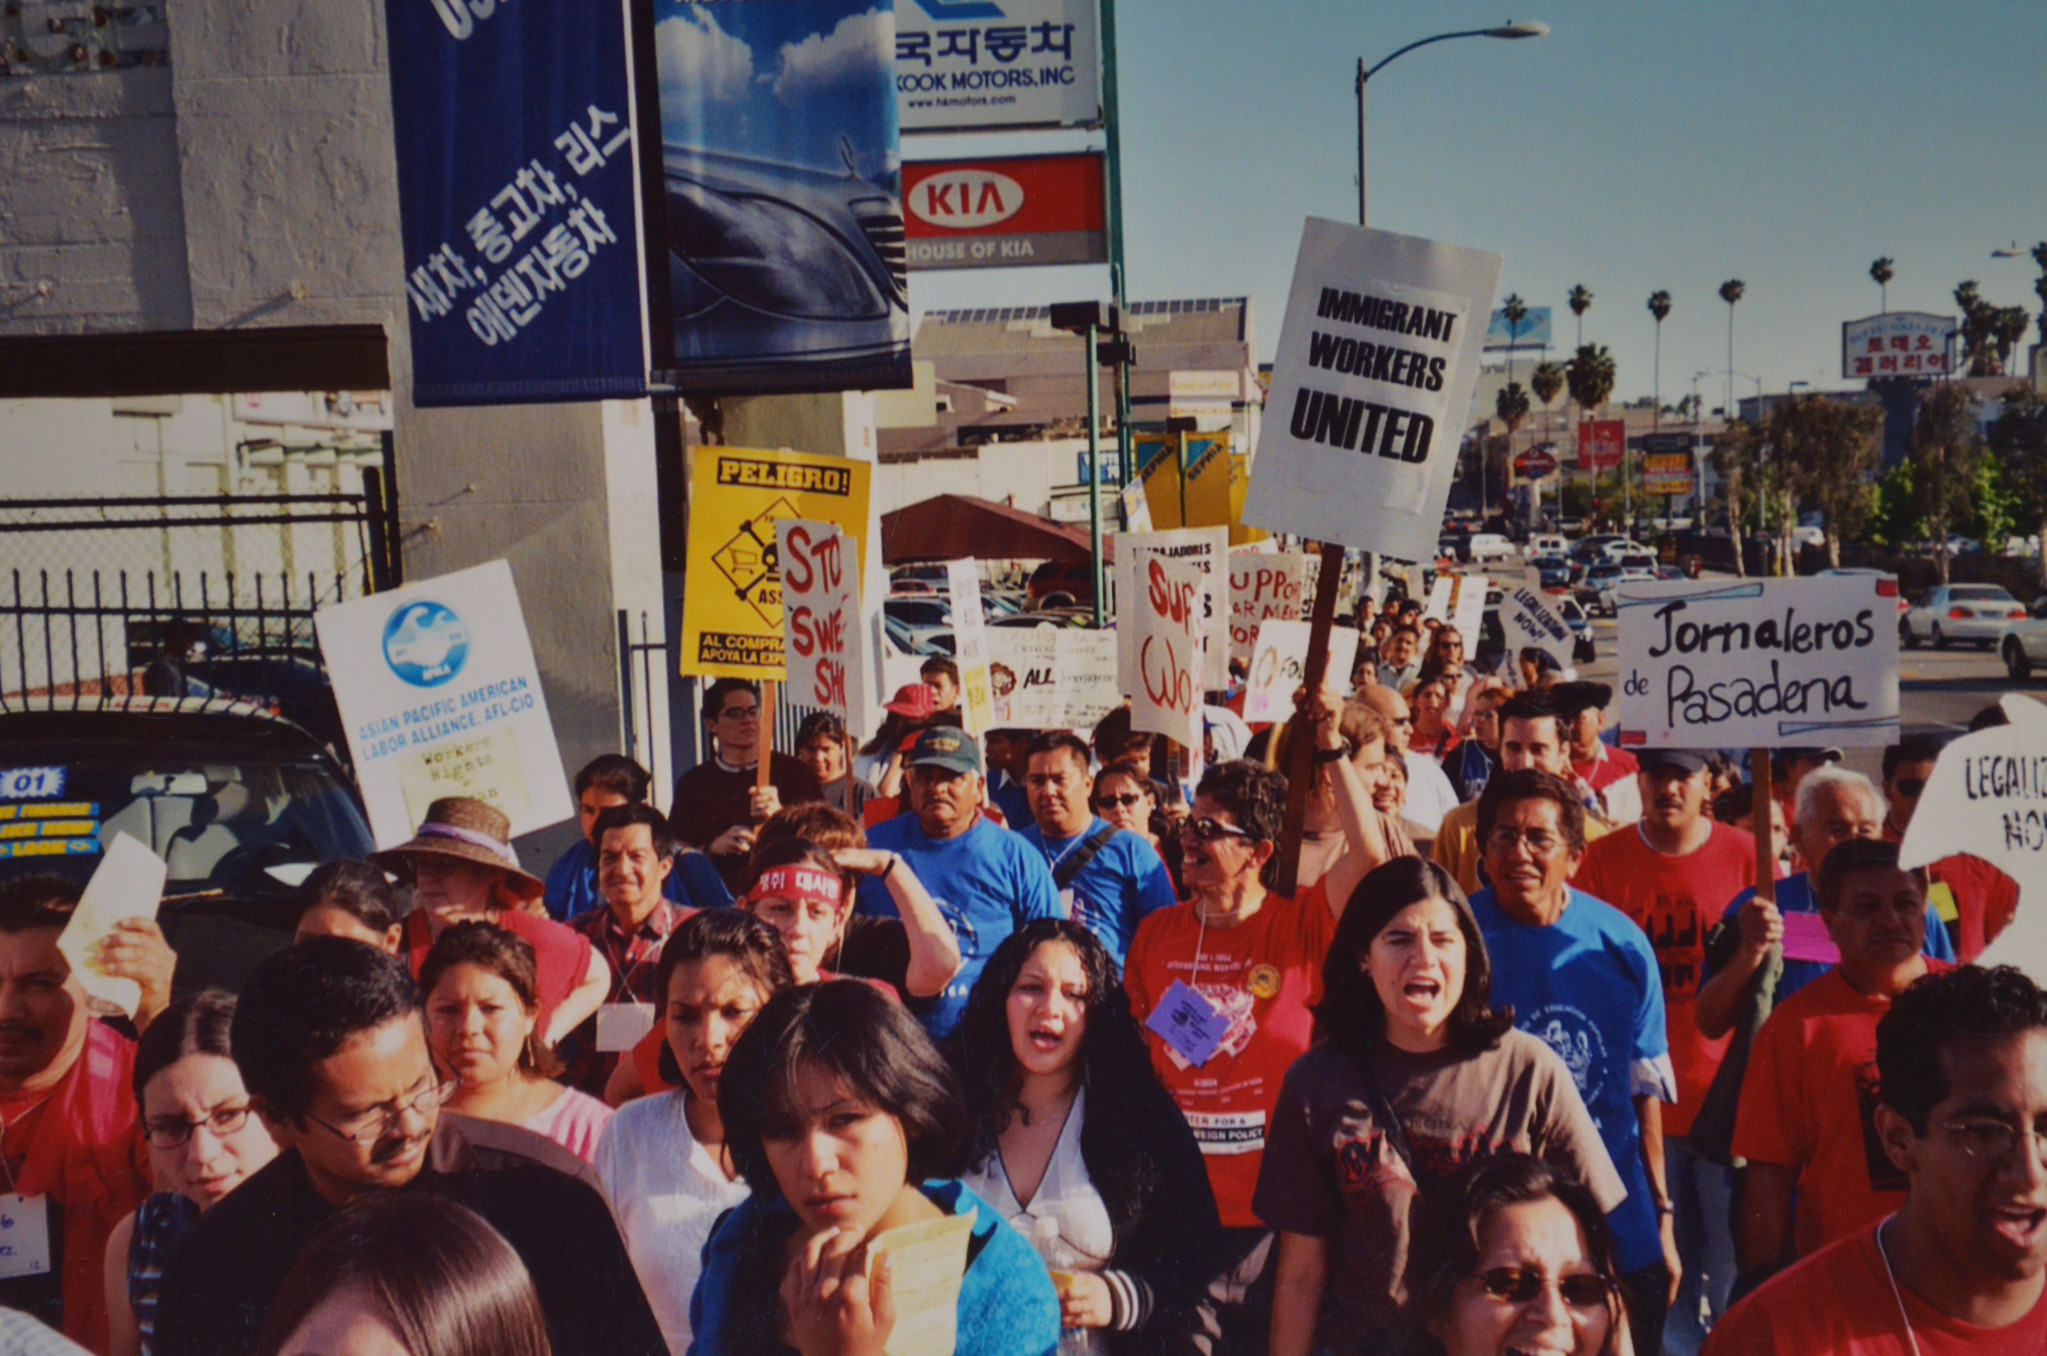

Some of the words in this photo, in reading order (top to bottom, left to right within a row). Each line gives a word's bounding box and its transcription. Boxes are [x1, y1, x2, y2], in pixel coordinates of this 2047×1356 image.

[553, 104, 631, 176] 리스
[926, 181, 1005, 217] KIA
[970, 241, 995, 258] OF
[1000, 240, 1034, 257] KIA
[1317, 287, 1457, 342] IMMIGRANT
[1309, 331, 1446, 391] WORKERS
[1290, 387, 1434, 463] UNITED
[719, 460, 848, 492] PELIGRO!
[703, 634, 722, 649] AL
[1648, 600, 1874, 657] Jornaleros
[359, 716, 400, 741] ASIAN
[402, 698, 457, 727] PACIFIC
[460, 676, 528, 708] AMERICAN
[1624, 668, 1659, 696] de
[1666, 659, 1868, 728] Pasadena
[362, 733, 408, 762] LABOR
[13, 773, 45, 792] 01
[1229, 1127, 1263, 1140] POLICY
